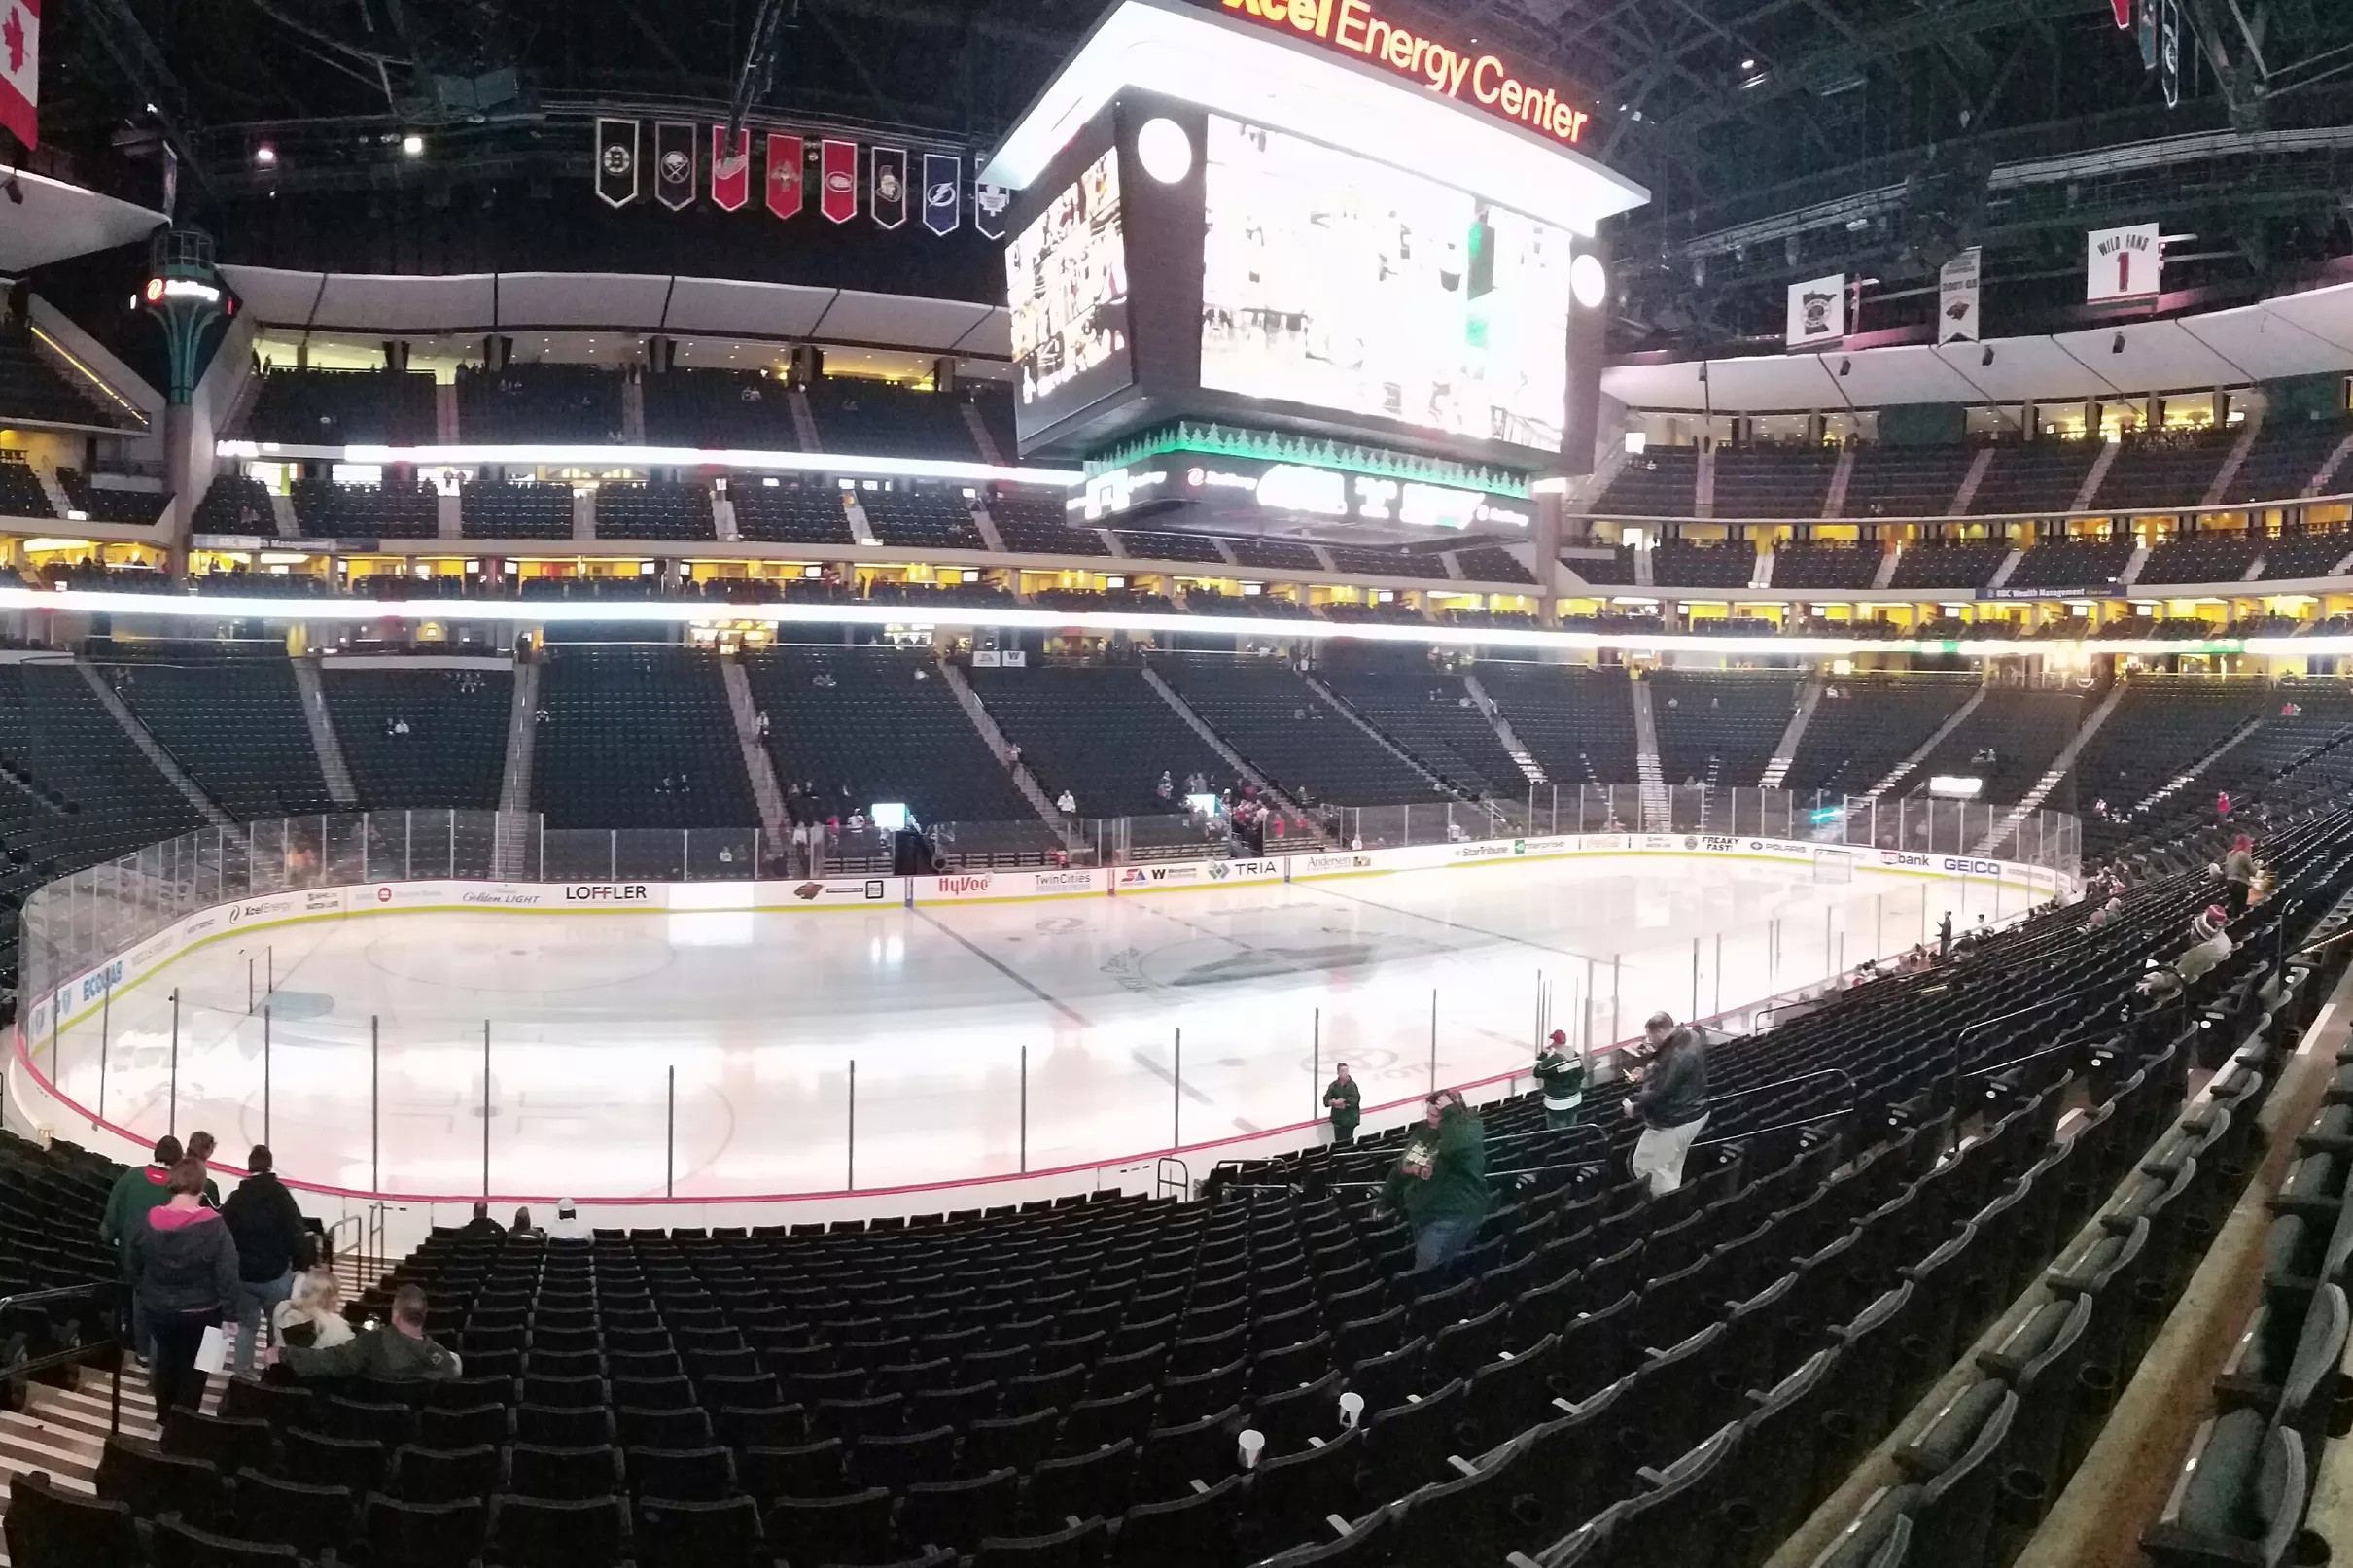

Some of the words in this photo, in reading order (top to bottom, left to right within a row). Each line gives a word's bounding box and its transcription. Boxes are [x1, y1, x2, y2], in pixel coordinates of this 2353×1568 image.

[1335, 0, 1470, 97] Energy
[1472, 55, 1589, 143] Center
[2097, 236, 2120, 256] WILD
[2125, 234, 2150, 252] FANS
[2116, 252, 2129, 292] 1
[2039, 588, 2085, 598] Management
[1702, 836, 1740, 845] FREAKY
[1706, 843, 1733, 852] FAST!
[1766, 843, 1807, 853] POLARIS
[1308, 855, 1351, 867] Andersen
[1944, 858, 2001, 875] GEICO
[1234, 861, 1277, 875] TRIA
[505, 895, 541, 904] LIGHT
[566, 886, 647, 900] LOFFLER
